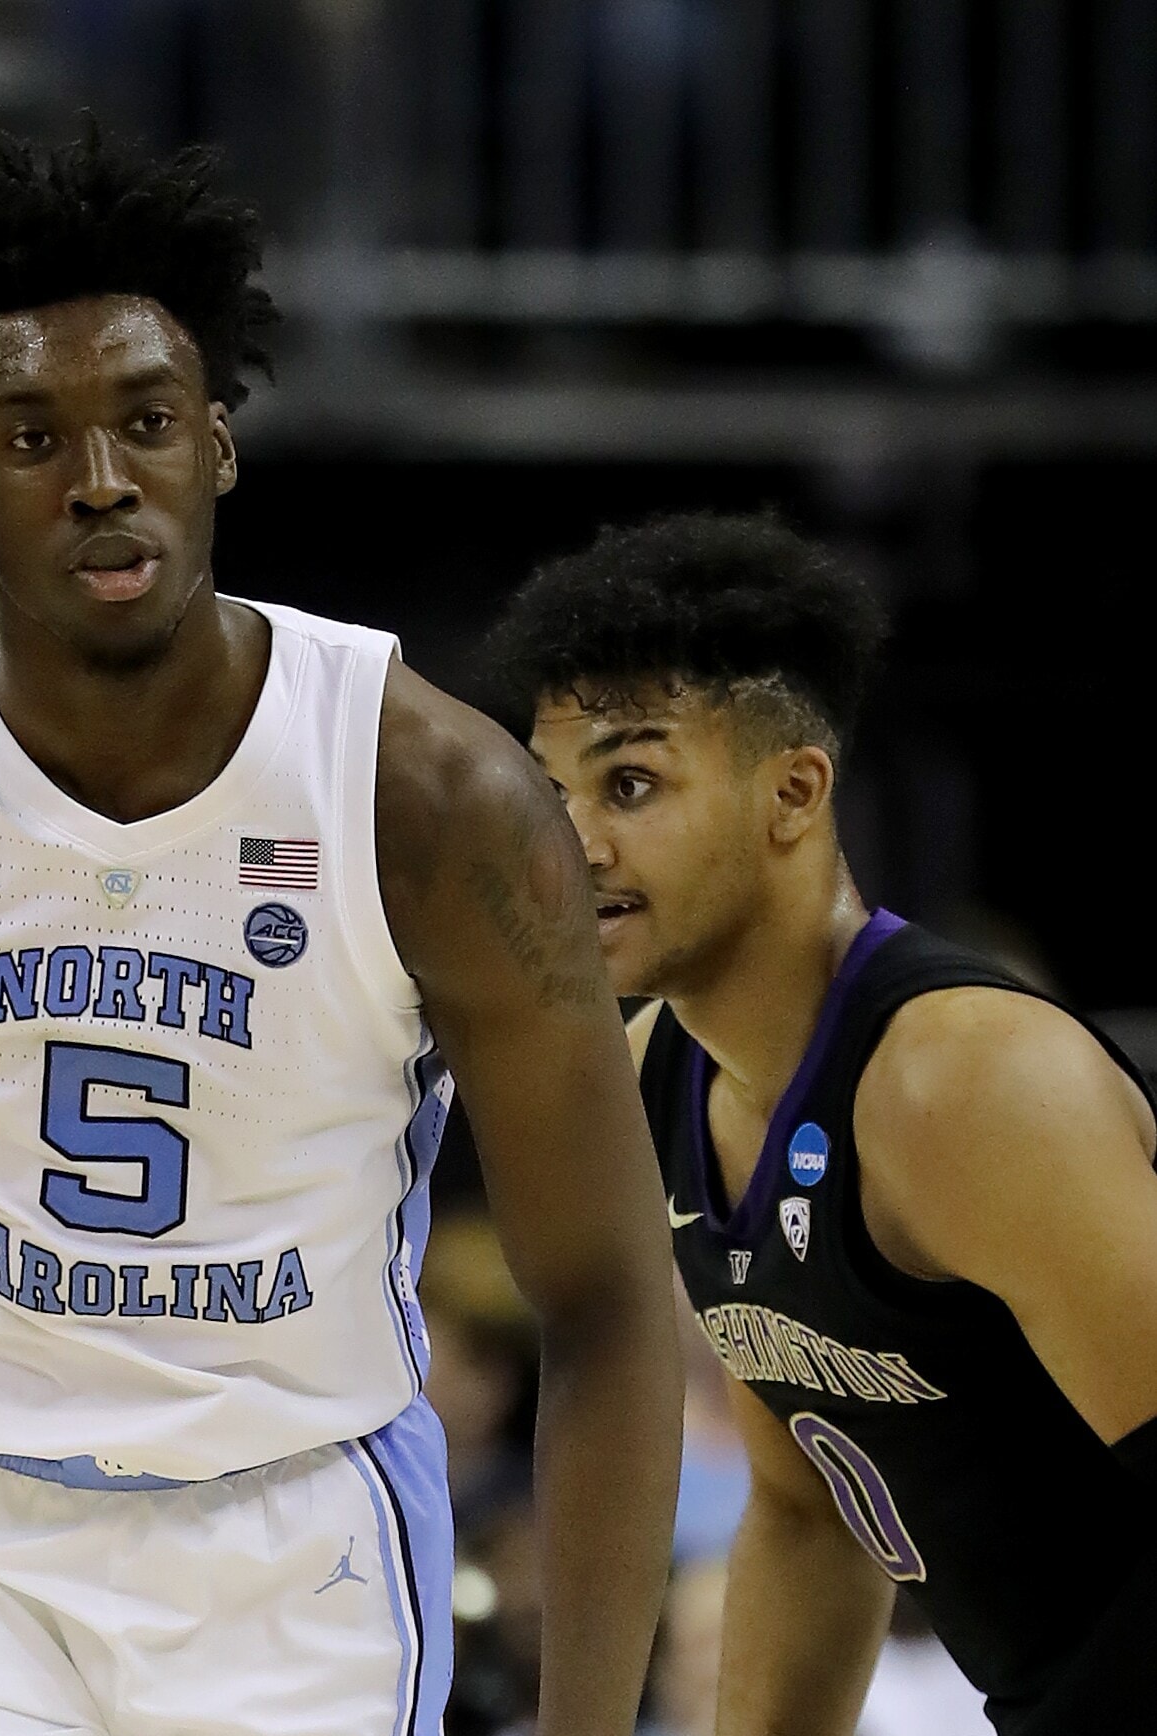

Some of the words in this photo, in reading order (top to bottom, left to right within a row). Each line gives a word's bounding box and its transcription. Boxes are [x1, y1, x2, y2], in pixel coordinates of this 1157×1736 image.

[252, 924, 304, 940] ACC
[39, 1040, 191, 1239] 5
[793, 1152, 826, 1171] NCAA
[695, 1303, 948, 1404] SHINGTON
[790, 1411, 927, 1582] 0
